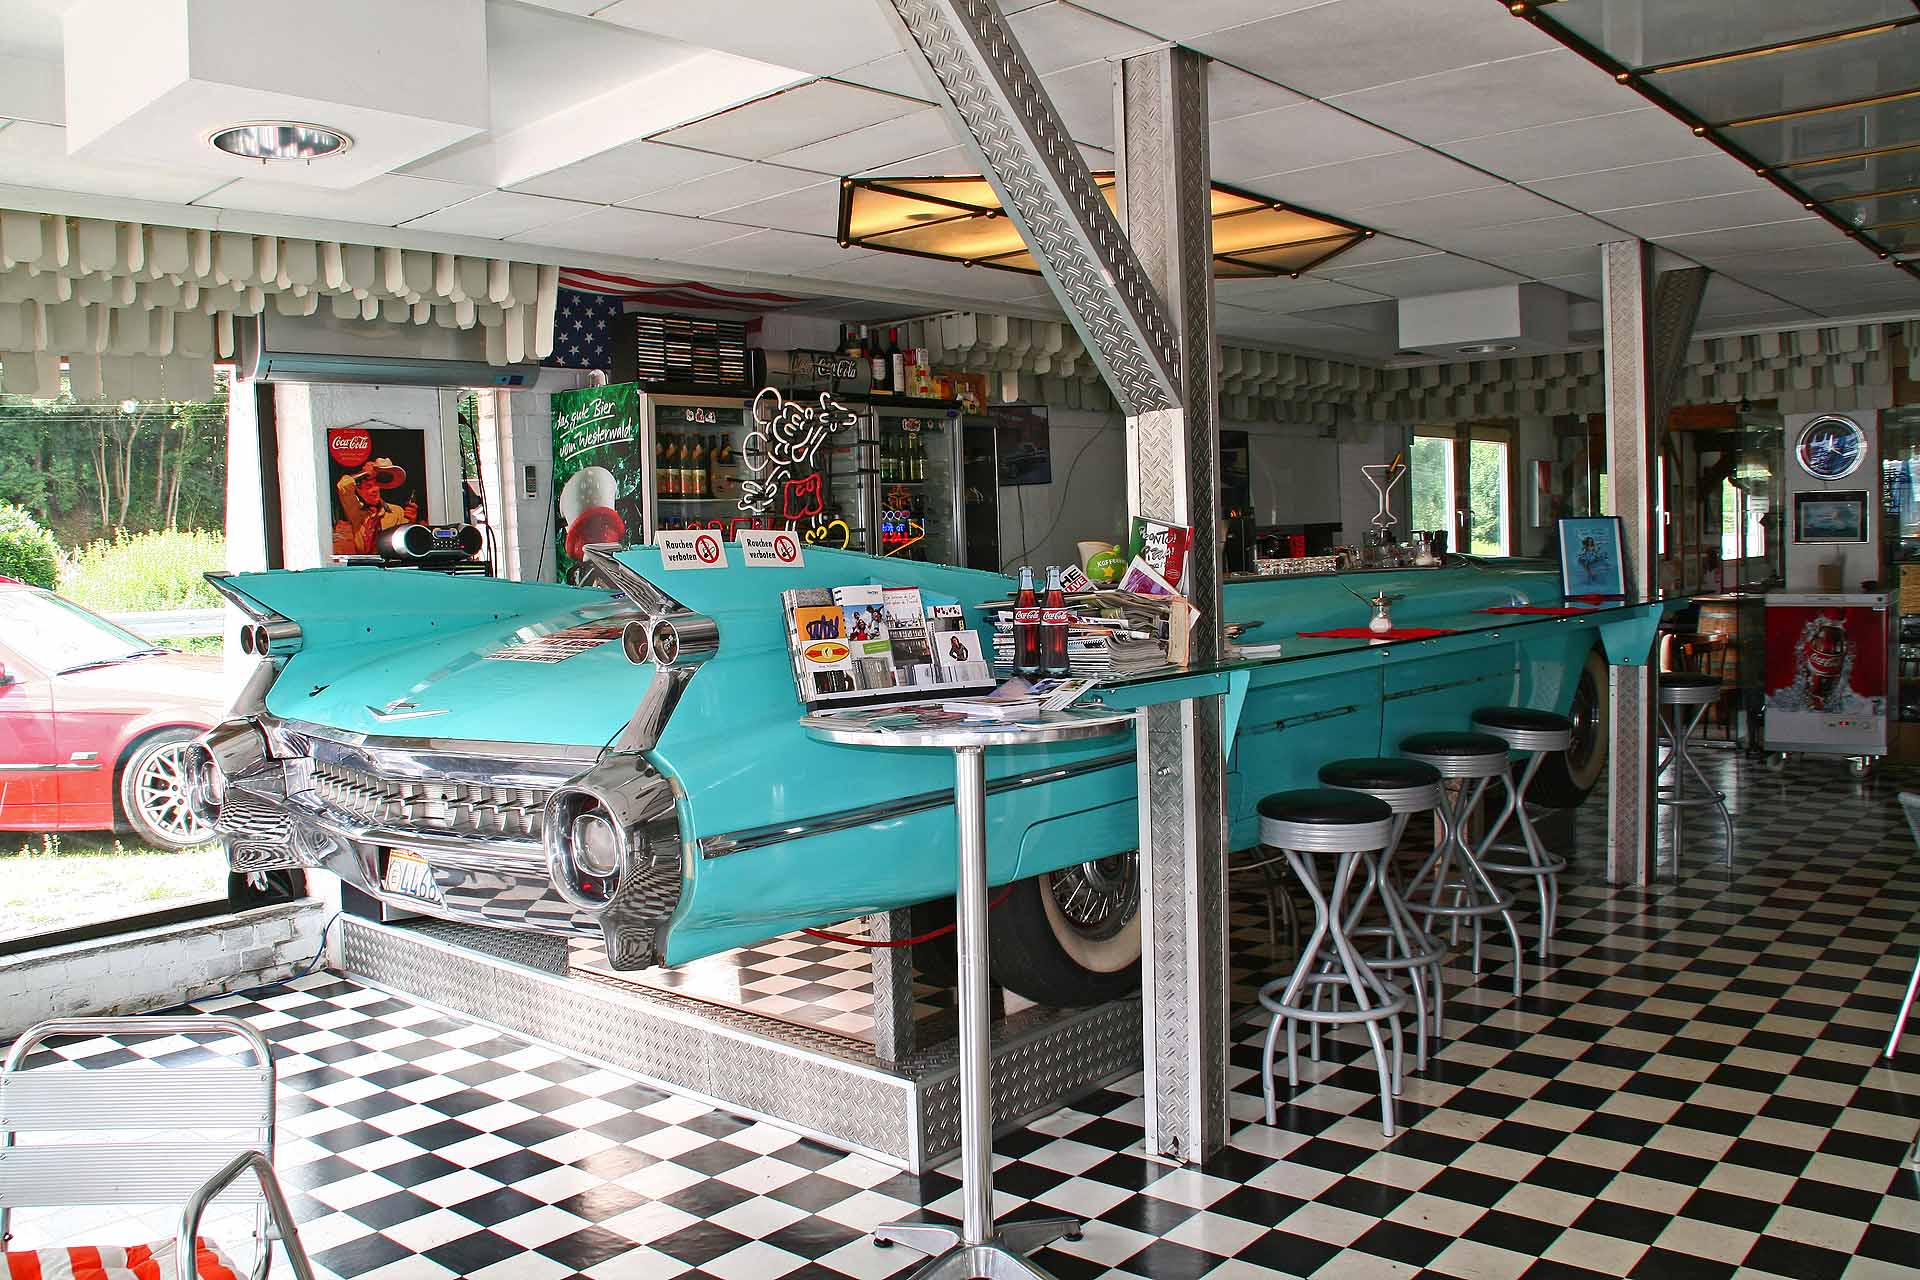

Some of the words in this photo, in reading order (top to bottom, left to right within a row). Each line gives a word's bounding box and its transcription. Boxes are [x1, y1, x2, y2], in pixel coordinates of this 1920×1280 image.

[590, 398, 616, 418] Bier
[574, 416, 632, 447] Westerwald
[665, 539, 694, 550] Rauchen
[746, 538, 773, 548] Rauchen
[668, 551, 698, 562] verboten
[750, 549, 777, 560] verboten
[1066, 576, 1087, 592] LIVE
